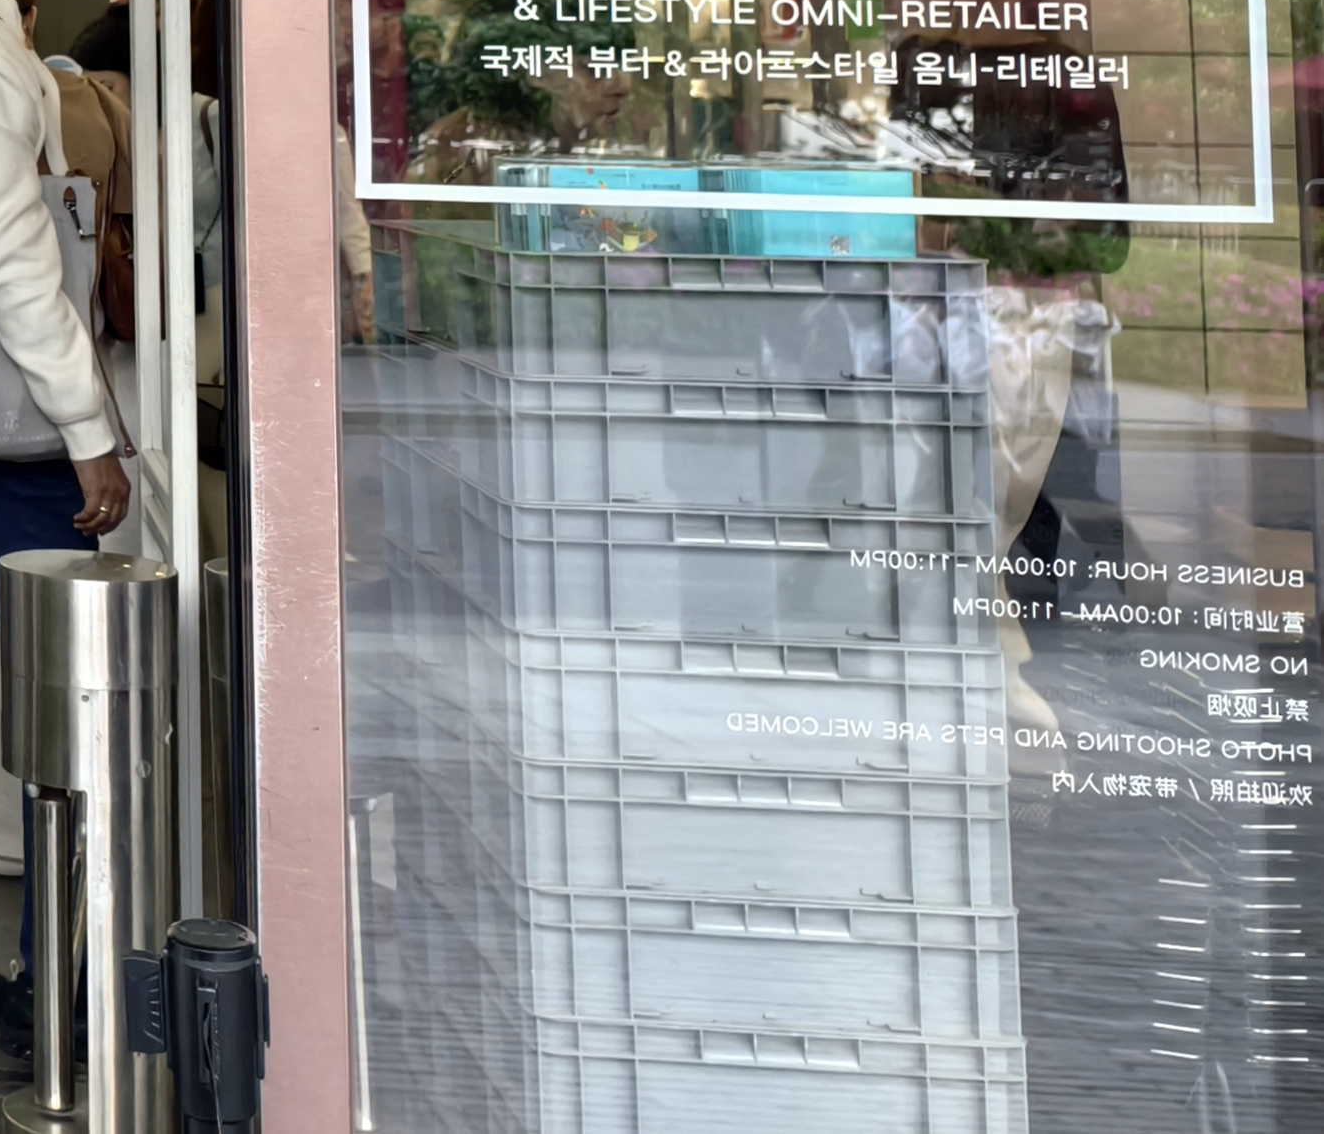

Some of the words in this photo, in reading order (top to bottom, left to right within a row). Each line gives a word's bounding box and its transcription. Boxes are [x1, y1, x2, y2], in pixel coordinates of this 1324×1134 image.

[480, 44, 574, 78] 국제적
[664, 49, 687, 76] &
[699, 47, 899, 85] 라이프스타일
[912, 51, 1129, 90] 옴니-리테일러
